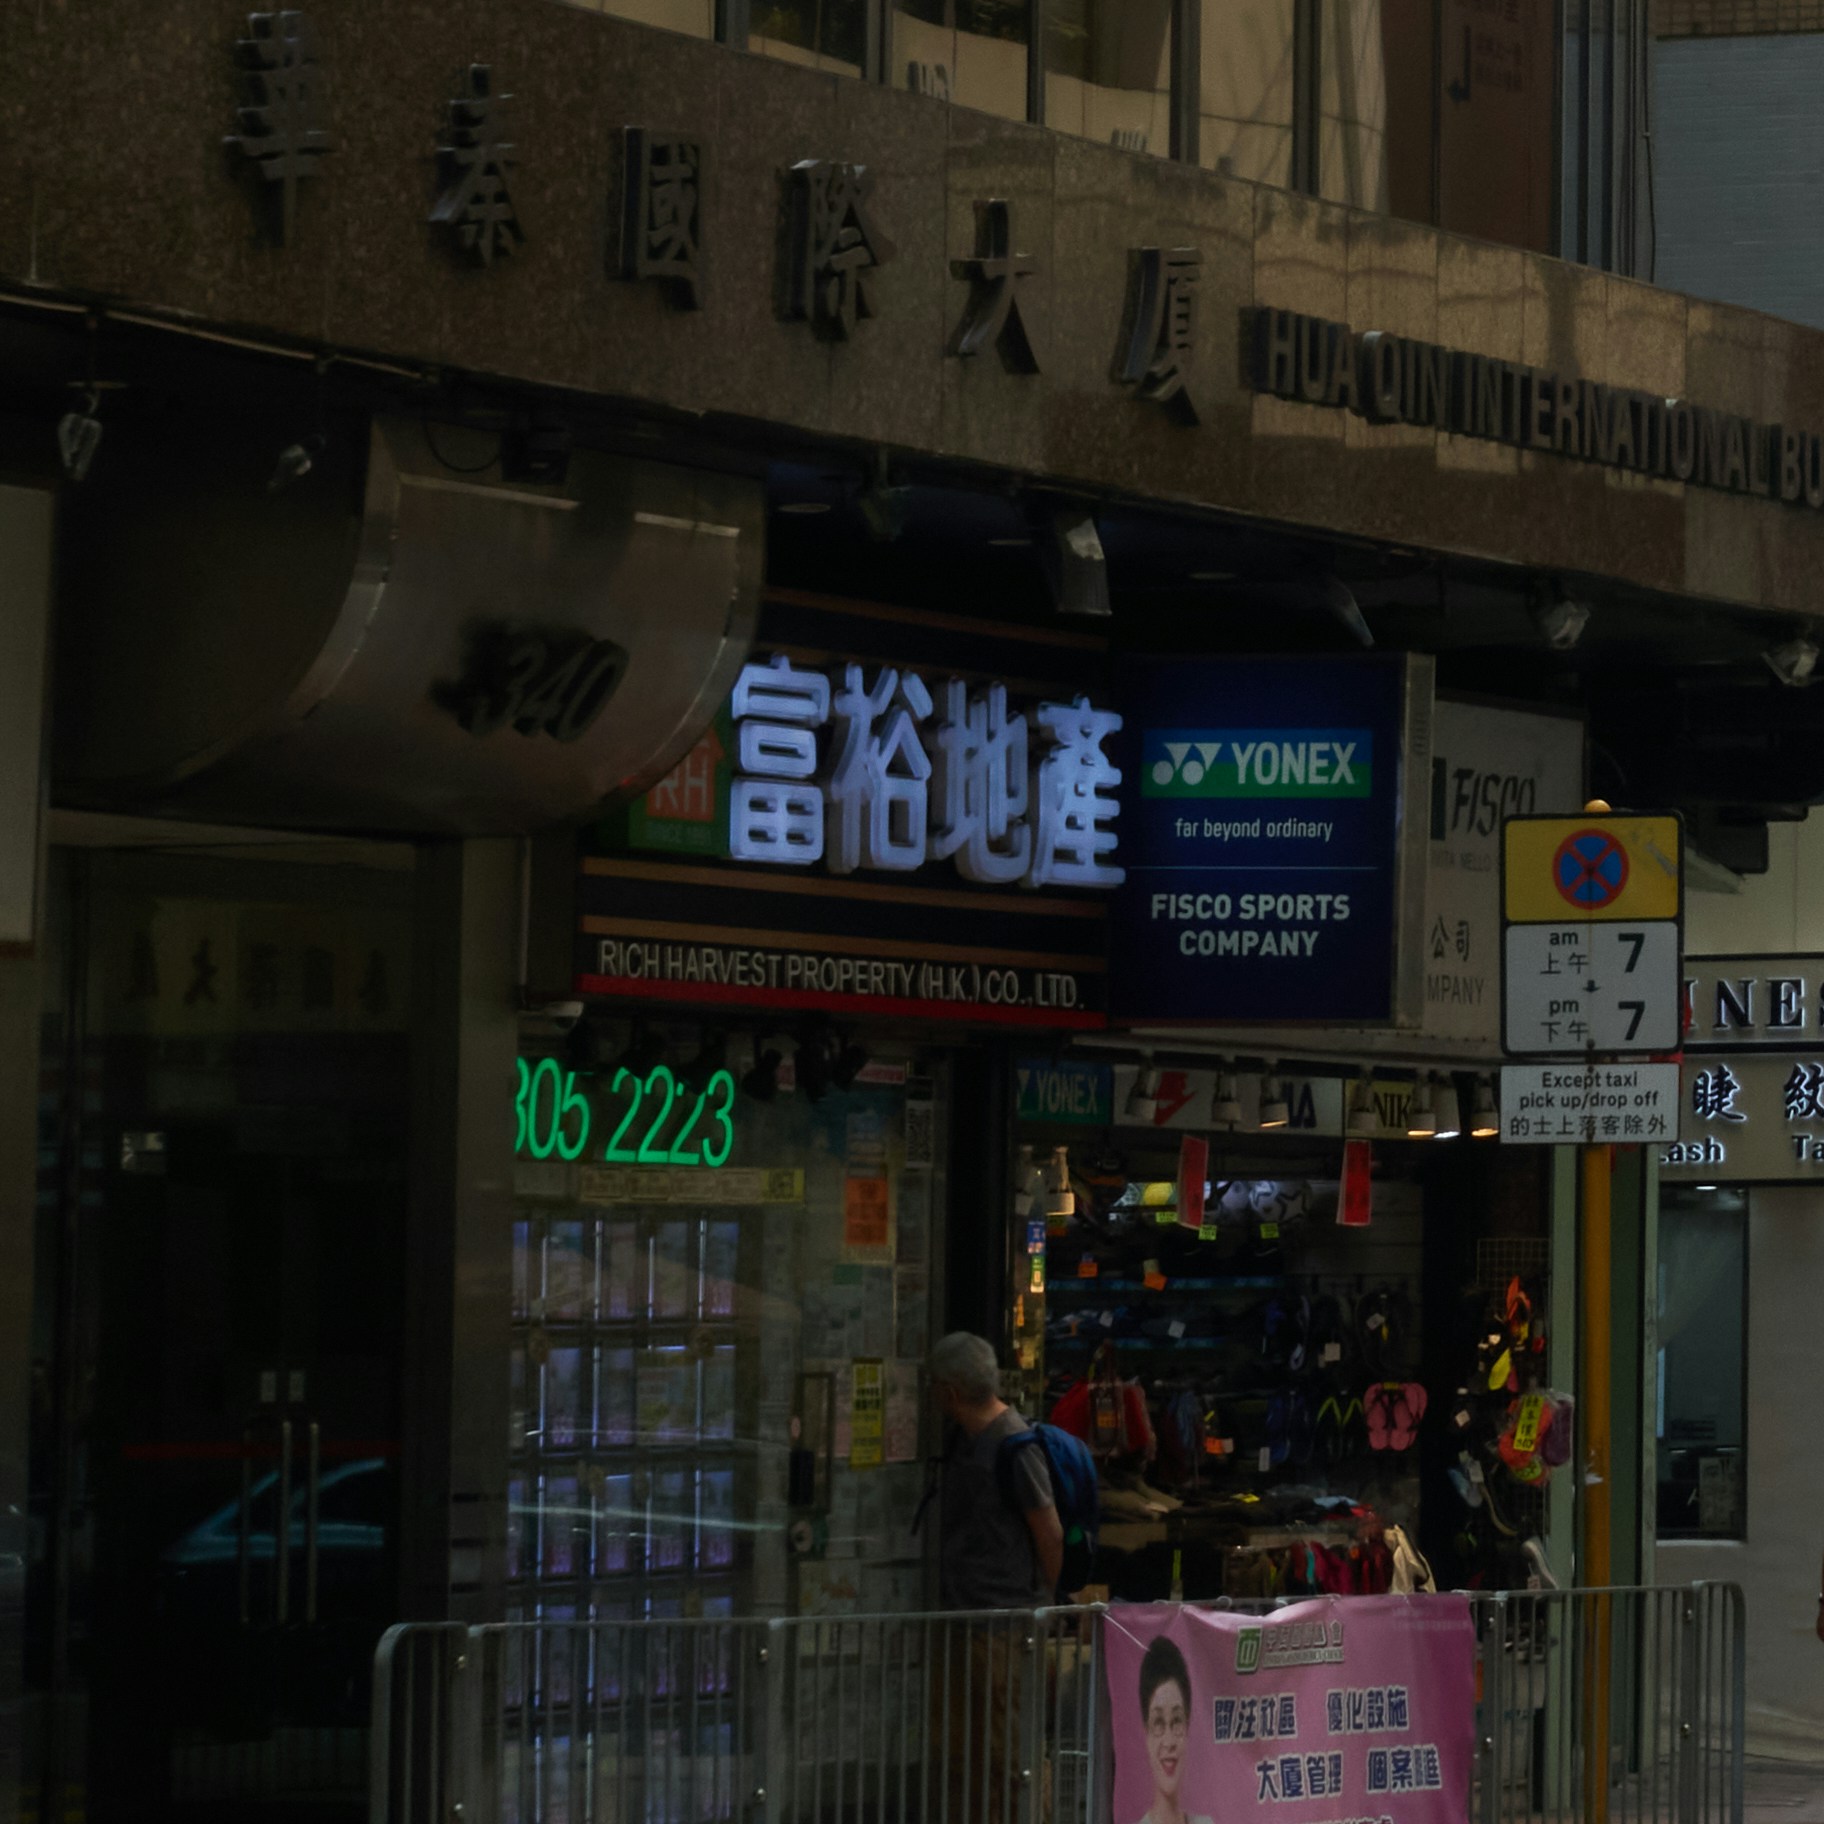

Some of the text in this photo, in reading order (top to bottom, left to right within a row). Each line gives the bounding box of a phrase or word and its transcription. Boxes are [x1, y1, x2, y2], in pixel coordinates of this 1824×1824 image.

[1246, 304, 1358, 410] HUA
[1360, 330, 1452, 434] QIN
[1455, 352, 1770, 498] INTERNATIONAL
[731, 652, 1127, 889] 富裕地產
[1231, 741, 1357, 786] YONEX
[1175, 817, 1334, 844] far beyond ordinary
[1151, 892, 1351, 923] FISCO SPORTS
[1180, 929, 1319, 958] COMPANY
[1431, 915, 1470, 963] 公司
[1550, 931, 1645, 973] am 7
[600, 939, 659, 980] RICH
[667, 944, 781, 989] HARVEST
[787, 952, 916, 1000] PROPERTY
[920, 961, 980, 1001] (H.K.)
[1540, 953, 1589, 975] 上午
[1540, 1021, 1589, 1044] 下午
[1550, 998, 1645, 1041] pm 7
[1035, 1074, 1099, 1115] YONEX
[1519, 1090, 1659, 1113] pick up/drop off
[1541, 1070, 1638, 1094] Except taxi
[605, 1065, 735, 1167] 2223
[1509, 1113, 1669, 1138] 的士上落客除外
[1214, 1686, 1409, 1741] 關注社區 優化設施
[1256, 1752, 1344, 1803] 大廈管理
